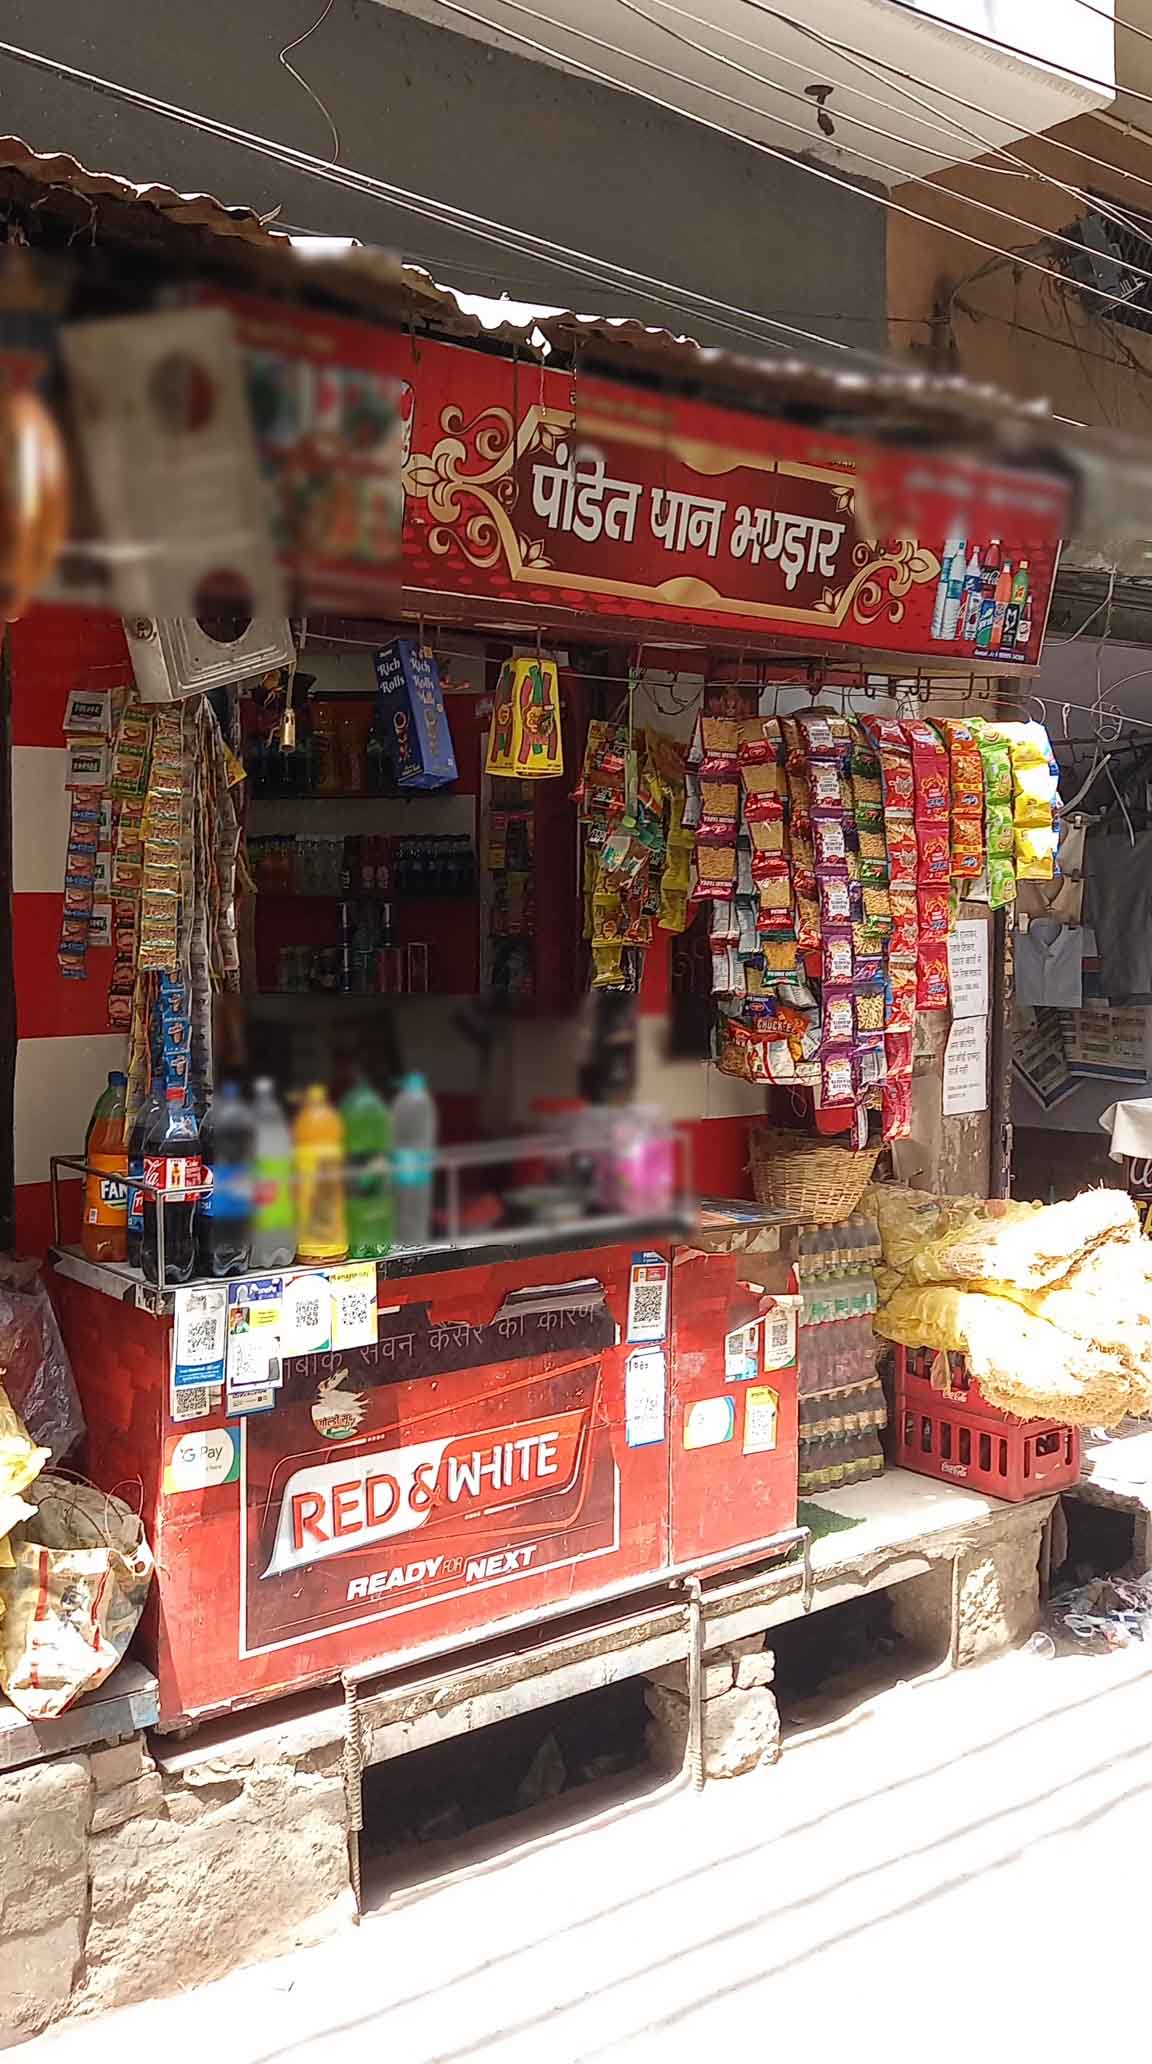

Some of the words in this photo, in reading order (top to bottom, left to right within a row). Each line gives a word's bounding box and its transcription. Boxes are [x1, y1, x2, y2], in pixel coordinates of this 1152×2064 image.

[531, 442, 643, 544] पंडित
[651, 487, 727, 558] पान
[101, 1179, 128, 1201] FAN
[200, 1445, 223, 1461] Pay
[346, 1554, 444, 1601] READY
[442, 1556, 464, 1573] FOR
[464, 1545, 537, 1583] NEXT
